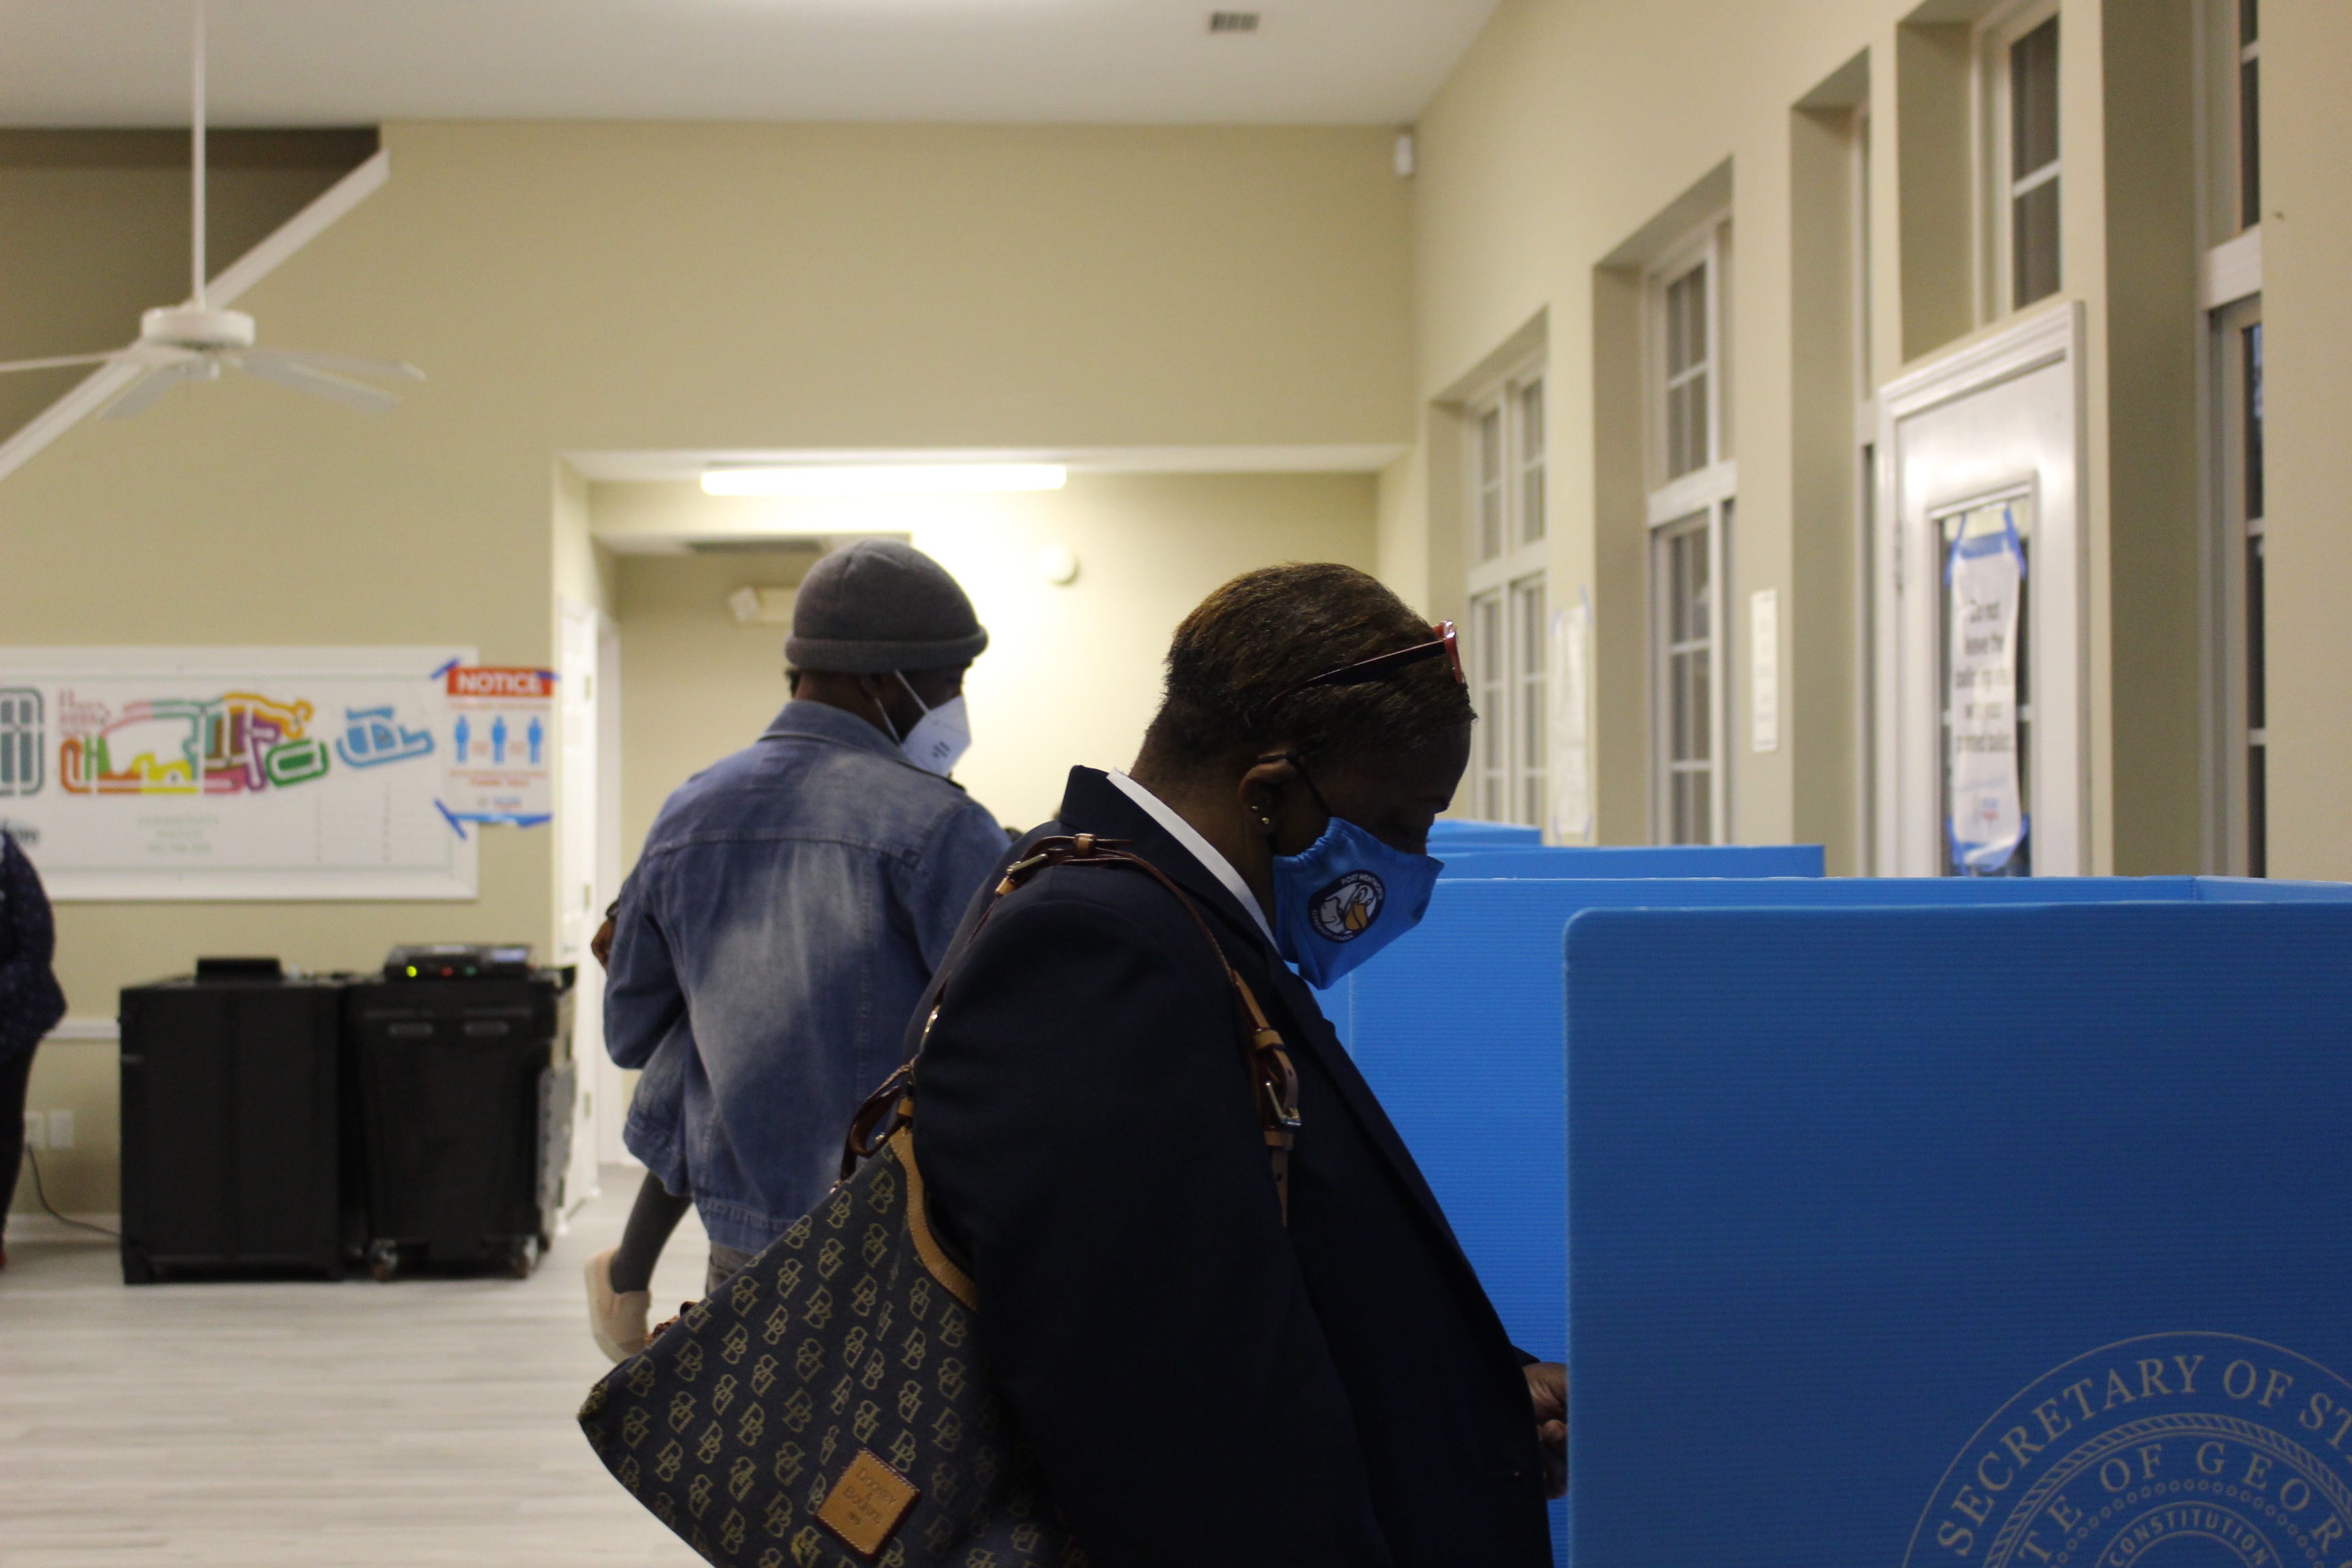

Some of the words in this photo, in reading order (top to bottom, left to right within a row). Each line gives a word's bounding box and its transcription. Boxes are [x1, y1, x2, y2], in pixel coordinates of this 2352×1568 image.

[457, 672, 542, 693] NOTICE
[1938, 1354, 2205, 1557] SECRETARY
[2223, 1360, 2294, 1407] OF
[2298, 1392, 2352, 1465] ST
[2100, 1443, 2163, 1492] OF
[2196, 1441, 2352, 1568] GEOR
[2109, 1508, 2268, 1567] CONSTITUTION
